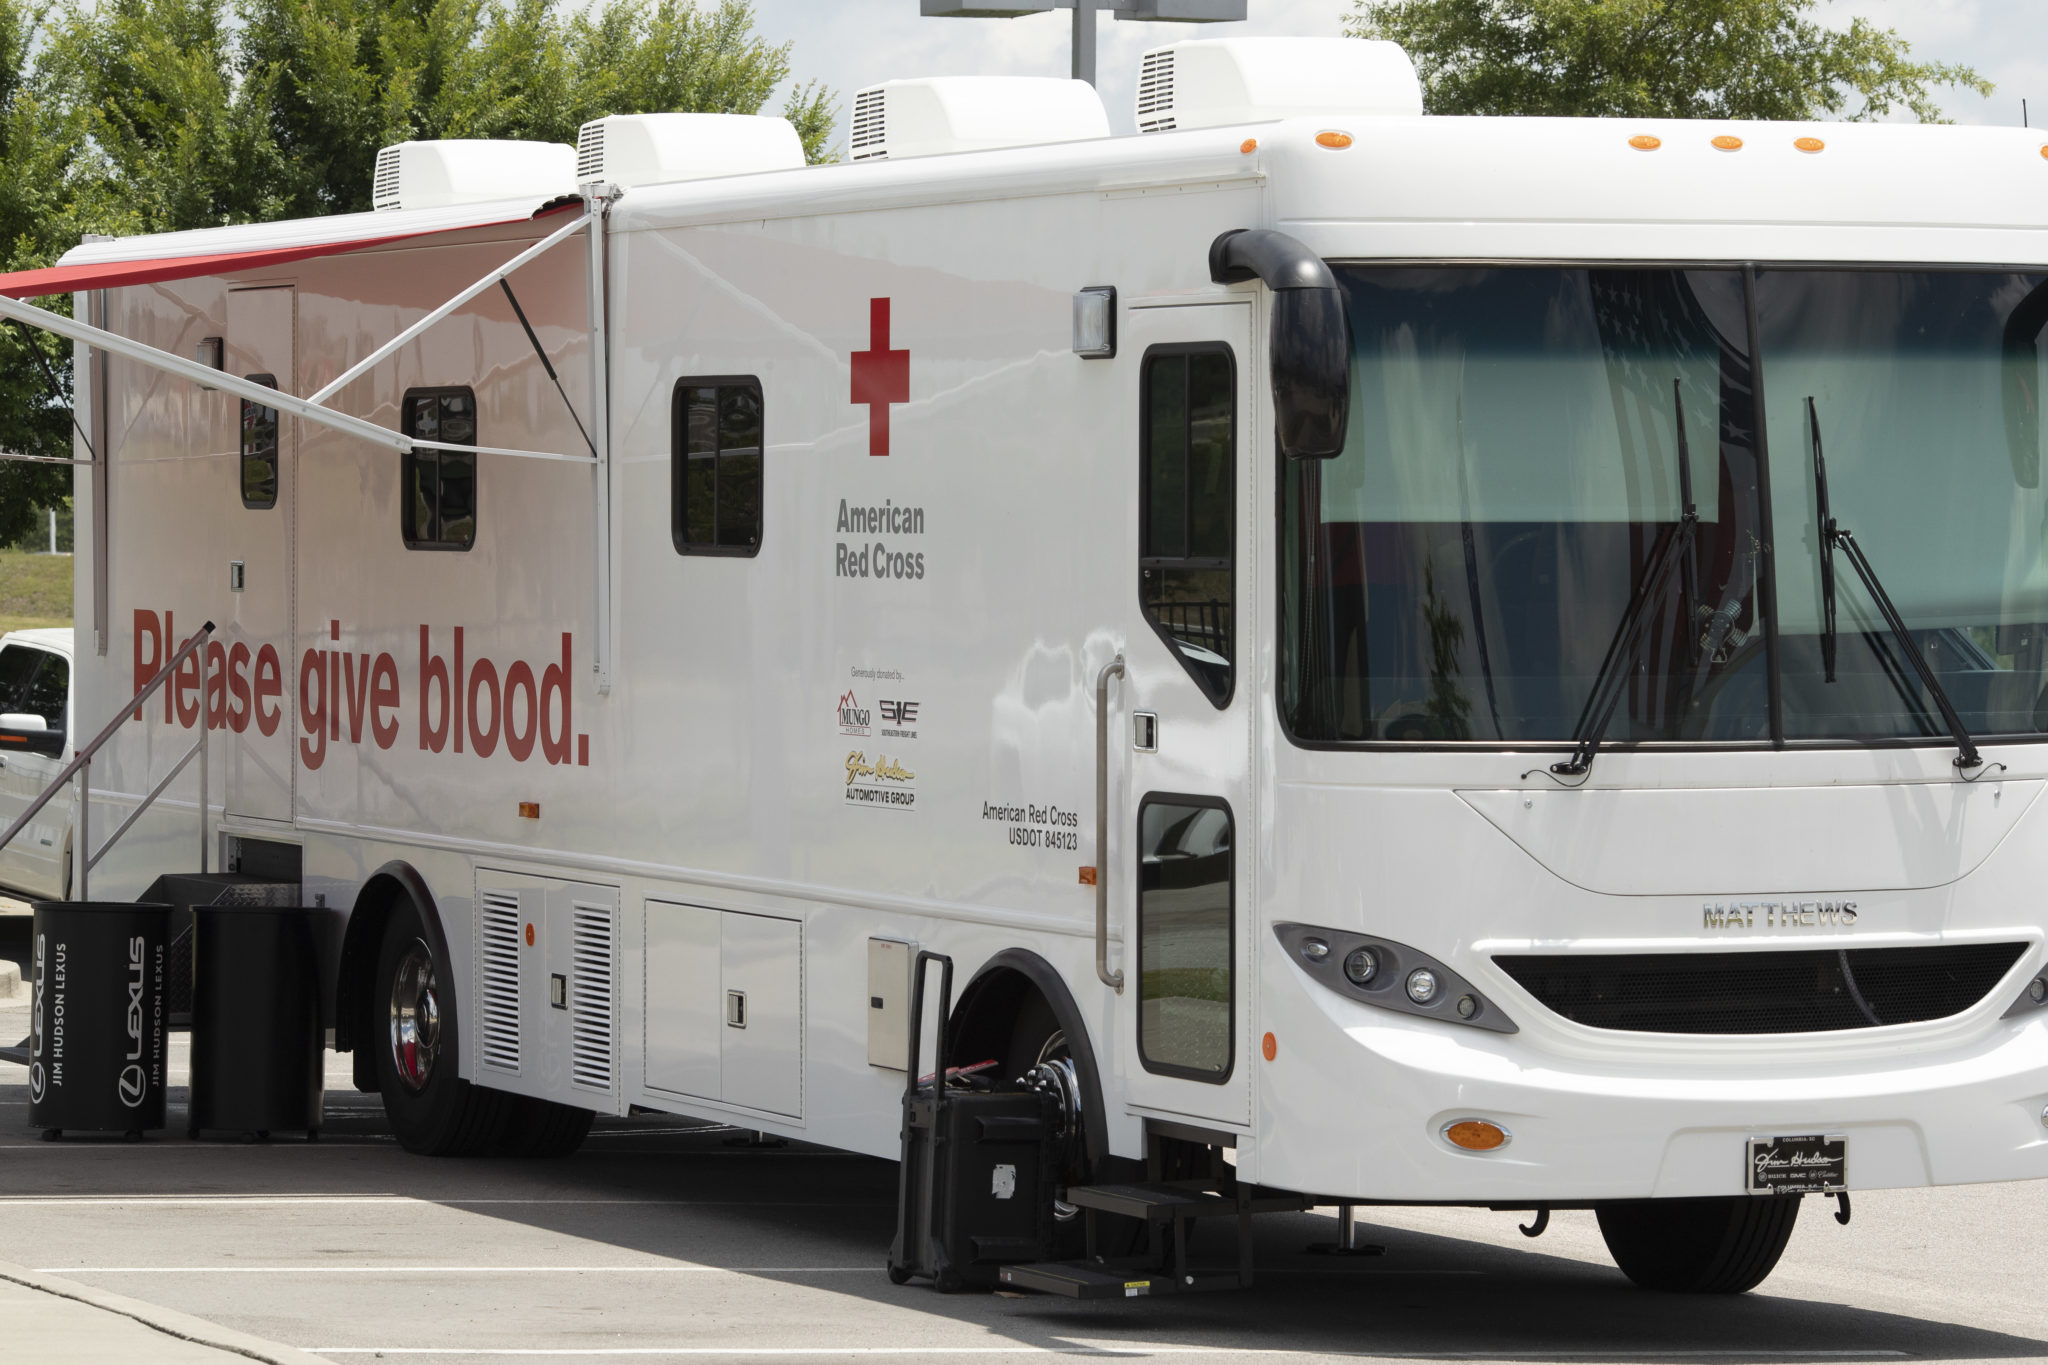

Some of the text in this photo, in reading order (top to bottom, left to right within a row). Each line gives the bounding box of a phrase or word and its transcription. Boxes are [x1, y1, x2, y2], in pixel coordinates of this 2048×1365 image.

[836, 498, 924, 534] American
[836, 542, 925, 580] Red Cross
[850, 665, 875, 681] Generously
[876, 667, 895, 680] donated
[133, 608, 590, 770] Please give blood.
[841, 708, 871, 726] MUNGO
[845, 727, 865, 736] HOMES
[846, 788, 915, 806] AUTOMOTIVE GROUP
[982, 800, 1078, 827] American Red Cross
[1009, 827, 1077, 851] USDOT 845123
[1703, 900, 1858, 929] MATTHEWS
[33, 933, 46, 1057] LEXUS
[126, 936, 145, 1060] LEXUS
[52, 943, 67, 1086] JIM HUDSON LEXUS
[152, 944, 164, 1087] JIM HUDSON LEXUS
[1754, 1148, 1844, 1172] Jim Hudson
